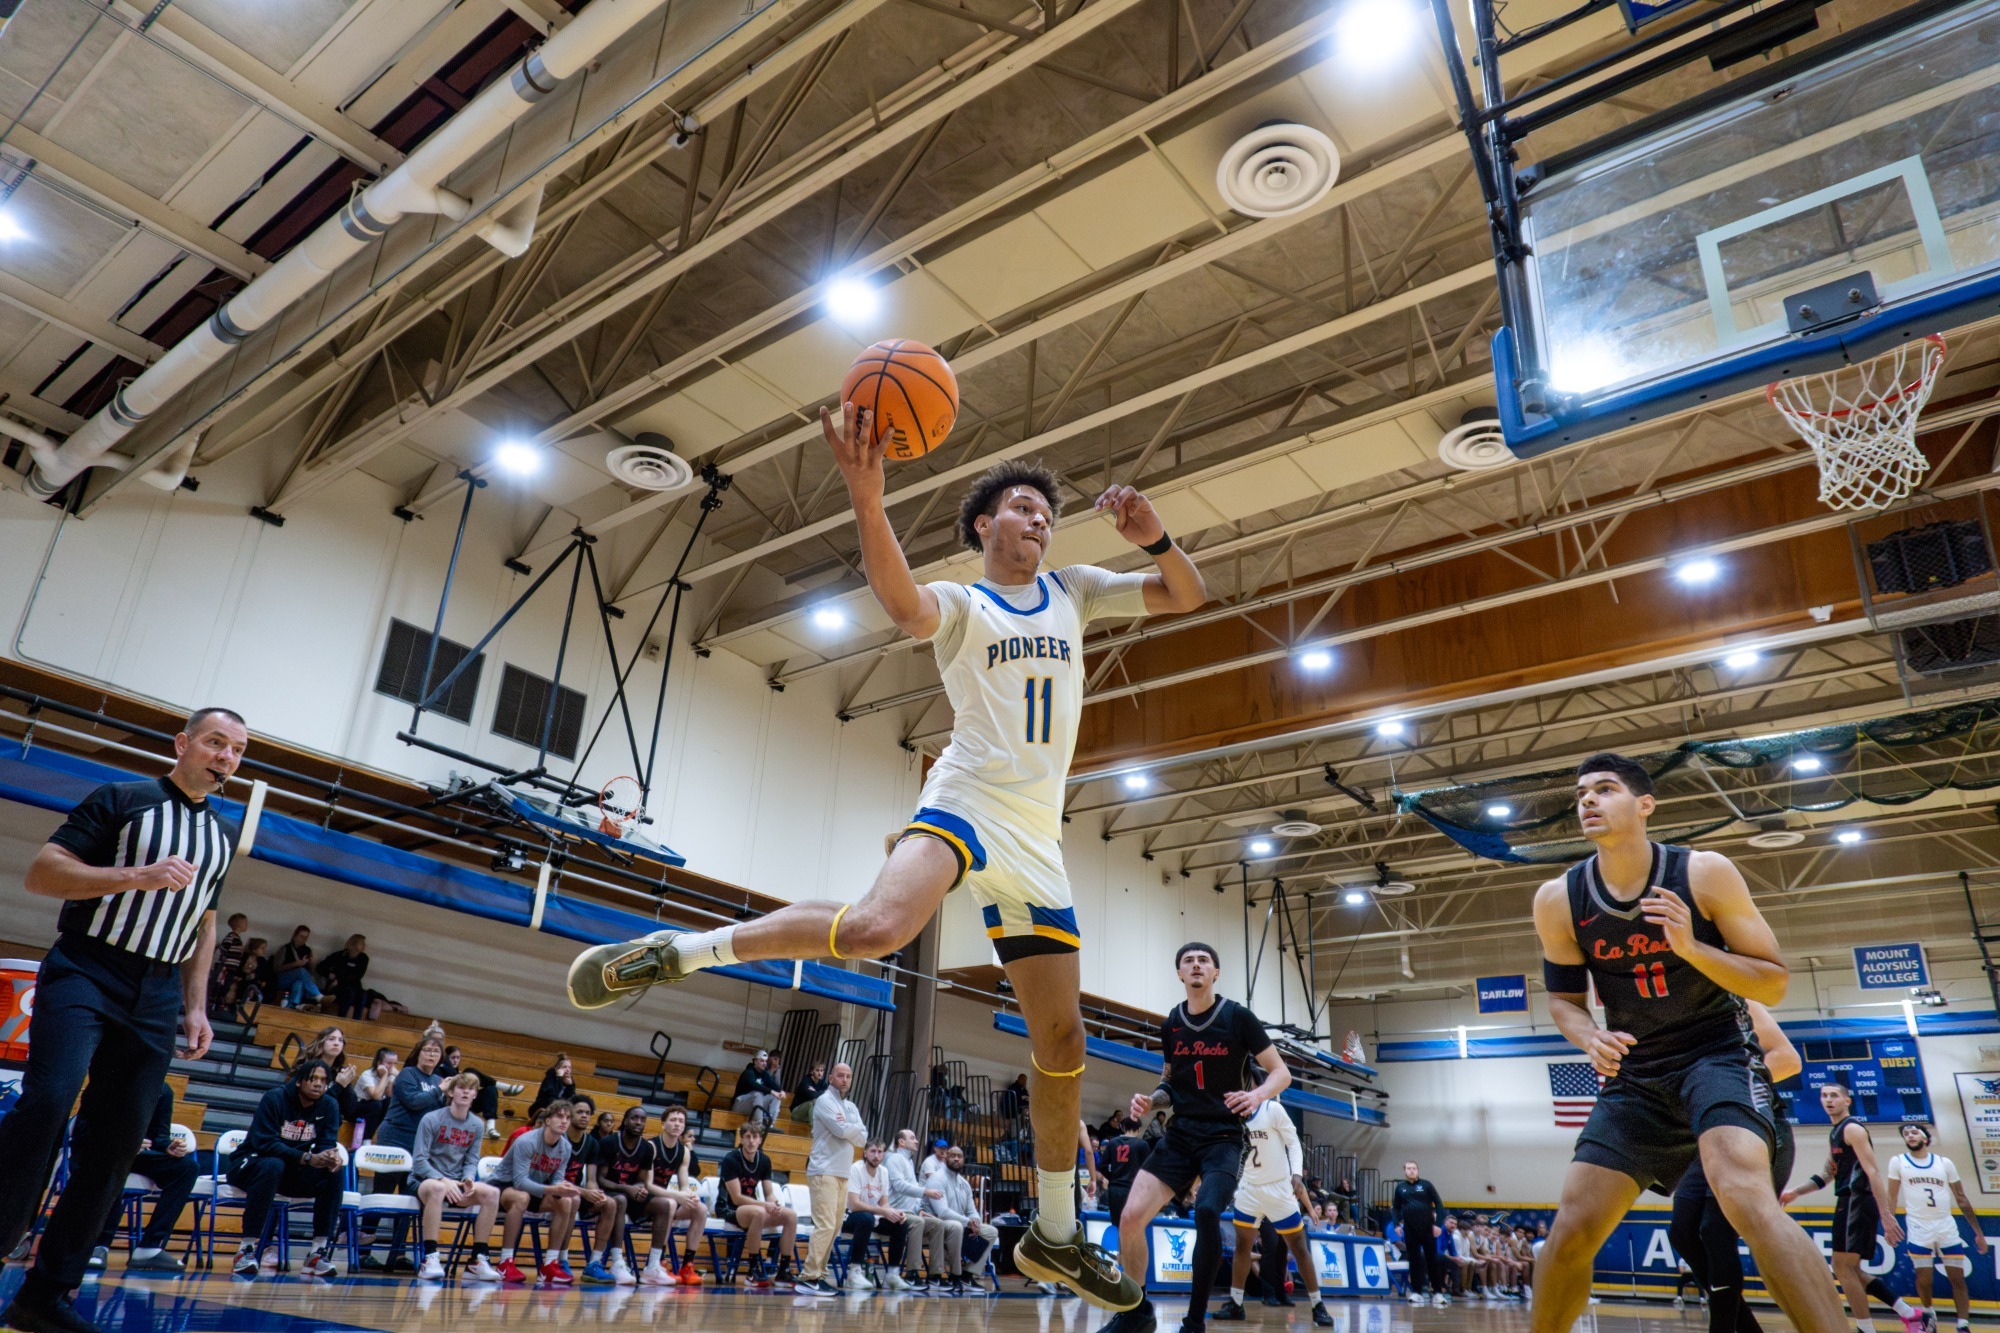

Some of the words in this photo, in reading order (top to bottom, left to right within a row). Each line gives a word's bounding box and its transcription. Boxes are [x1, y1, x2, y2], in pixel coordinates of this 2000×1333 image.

[987, 635, 1071, 671] PIONEER
[1023, 675, 1054, 745] 11
[1594, 938, 1624, 960] La
[1627, 933, 1673, 957] Roc
[1866, 948, 1910, 961] MOUNT
[1863, 960, 1919, 973] ALOYSIUS
[1633, 961, 1670, 998] 11
[1866, 972, 1920, 984] COLLEGE
[1481, 988, 1524, 1000] CARLOW
[1173, 1041, 1189, 1056] La
[1191, 1040, 1229, 1057] Roche
[1878, 1056, 1916, 1068] GUEST
[1194, 1061, 1205, 1090] 1
[1896, 1087, 1922, 1095] FOULS
[1901, 1114, 1929, 1122] SCORE
[438, 1125, 475, 1149] LRU
[365, 1151, 387, 1159] ALFRED
[1116, 1145, 1129, 1163] 12
[1251, 1145, 1262, 1168] 2
[1908, 1177, 1945, 1187] PIONEERS
[1924, 1188, 1936, 1208] 3
[1162, 1262, 1181, 1271] ALFRED
[1182, 1263, 1193, 1271] STAT
[1365, 1265, 1380, 1277] NCAA
[1162, 1270, 1194, 1281] PIONEER
